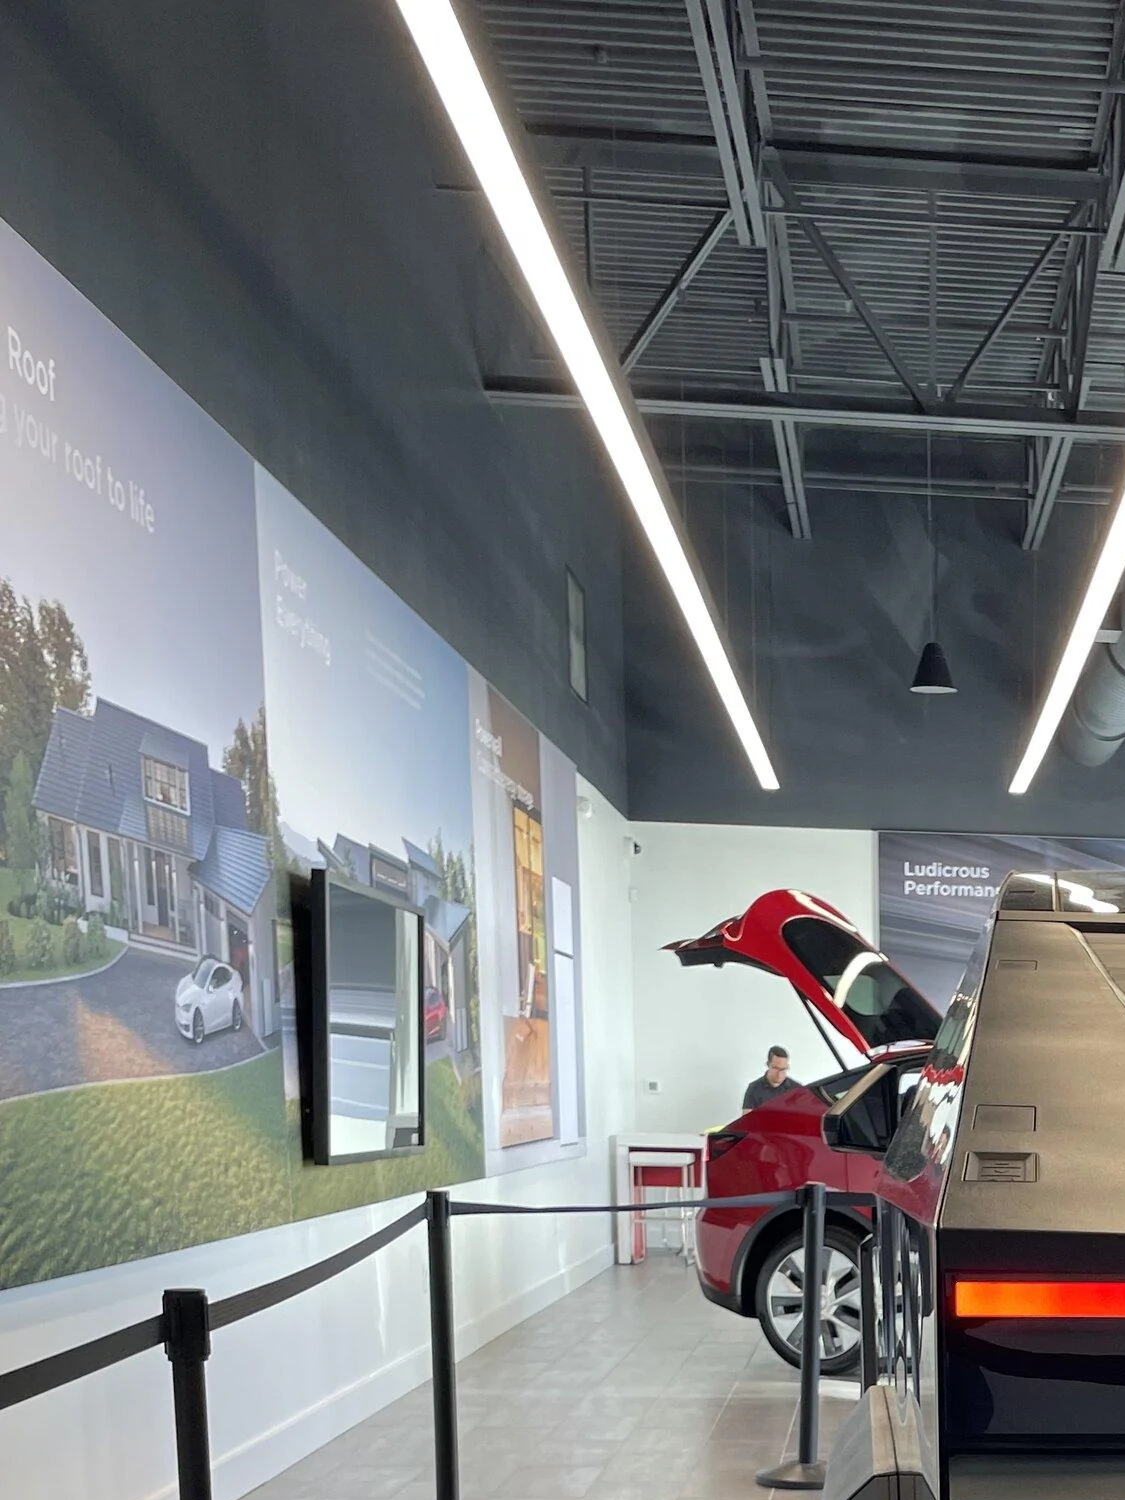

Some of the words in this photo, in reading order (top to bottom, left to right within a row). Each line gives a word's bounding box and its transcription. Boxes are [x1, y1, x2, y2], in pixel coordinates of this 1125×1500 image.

[8, 325, 56, 401] Roof
[14, 402, 58, 463] your
[65, 441, 102, 495] roof
[107, 466, 125, 512] to
[129, 480, 155, 533] life
[903, 861, 990, 878] Ludicrous
